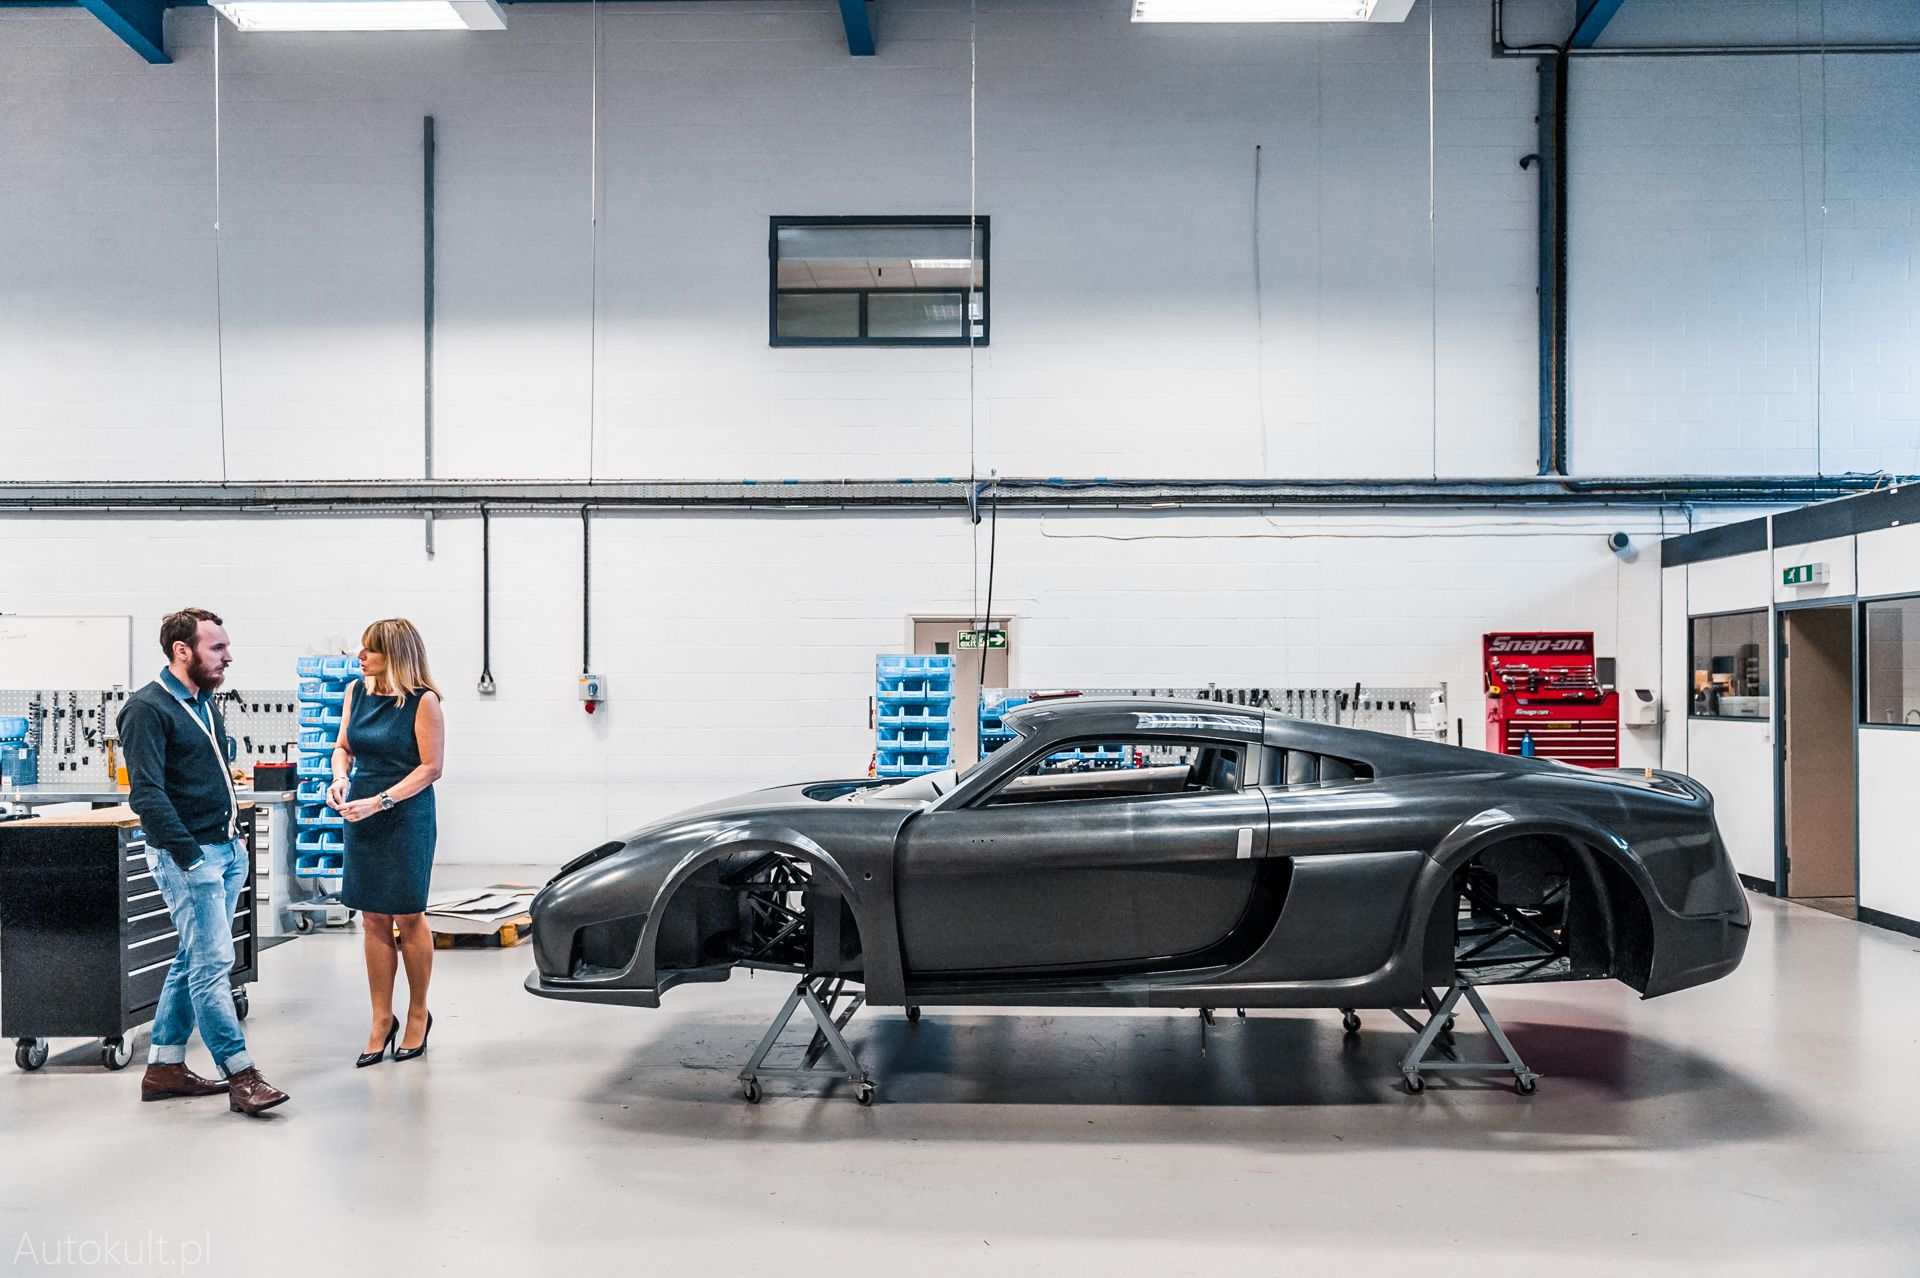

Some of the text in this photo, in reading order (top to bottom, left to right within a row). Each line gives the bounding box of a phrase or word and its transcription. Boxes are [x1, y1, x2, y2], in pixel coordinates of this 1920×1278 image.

[960, 633, 976, 641] Fire
[1488, 636, 1584, 654] Snap-on
[1515, 708, 1549, 716] Snap-on
